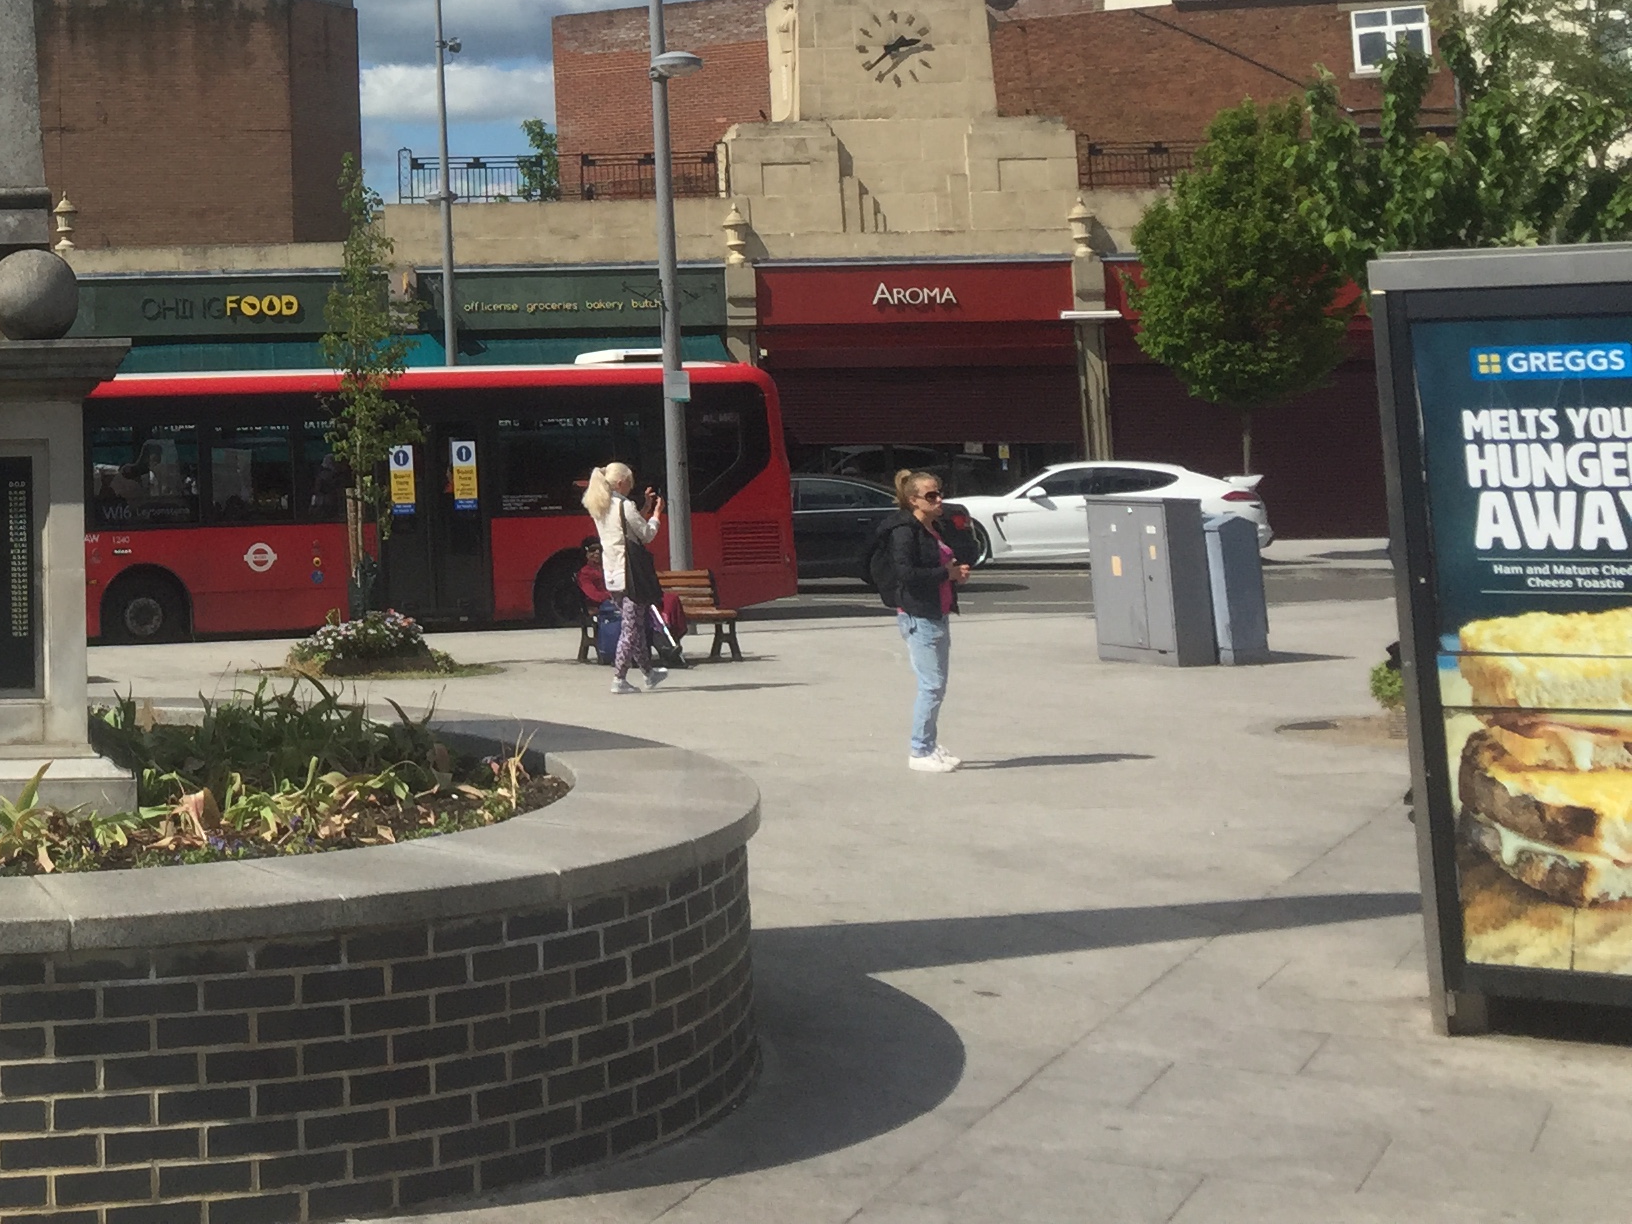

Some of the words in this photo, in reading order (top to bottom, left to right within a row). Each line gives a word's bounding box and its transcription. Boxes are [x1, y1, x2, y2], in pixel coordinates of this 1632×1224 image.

[526, 301, 578, 314] groceries
[586, 299, 624, 311] bakery
[631, 298, 662, 309] butch
[1506, 349, 1626, 374] GREGGS
[1461, 408, 1560, 441] MELTS
[1565, 407, 1632, 439] YOU
[1465, 441, 1632, 489] HUNGE
[102, 506, 132, 520] W16
[1492, 563, 1523, 574] Ham
[1526, 563, 1550, 575] and
[1552, 564, 1600, 575] Mature
[1601, 564, 1632, 576] Ched
[1526, 577, 1574, 588] Cheese
[1575, 577, 1625, 588] Toastie
